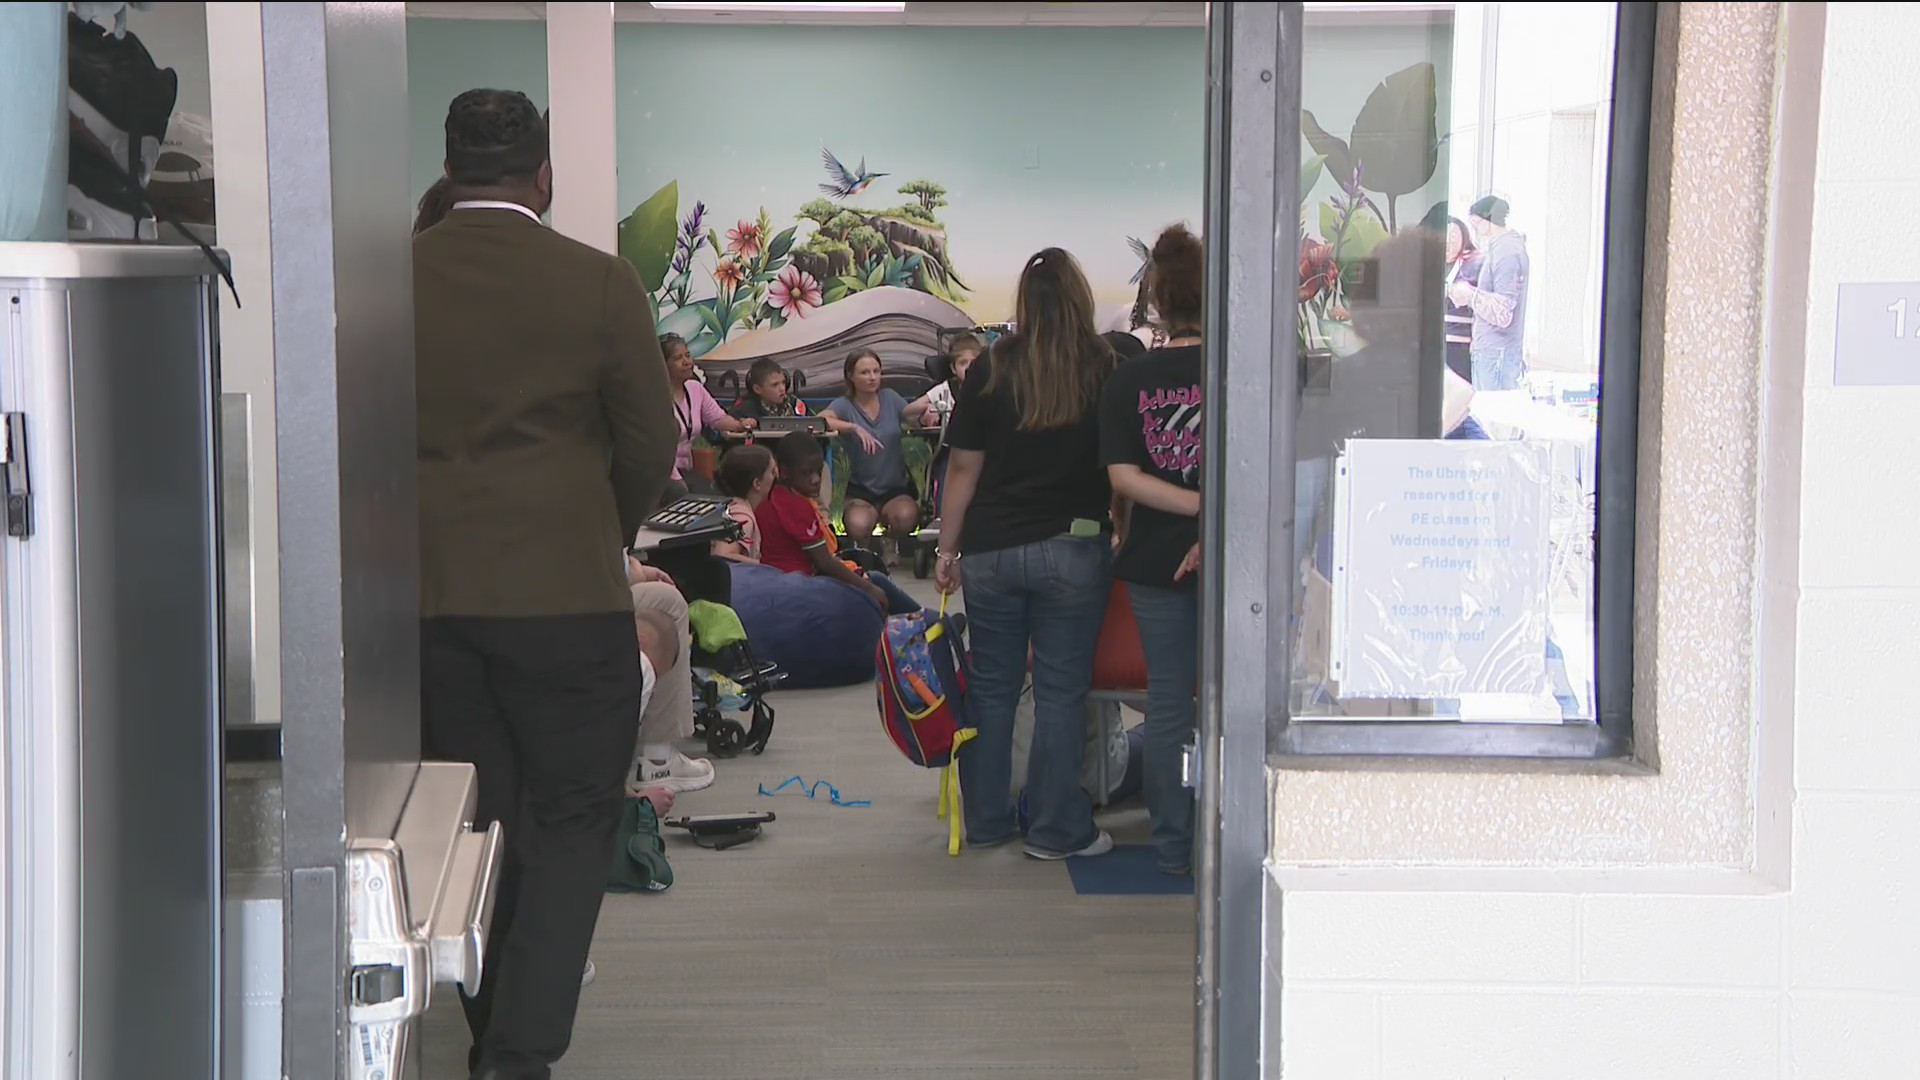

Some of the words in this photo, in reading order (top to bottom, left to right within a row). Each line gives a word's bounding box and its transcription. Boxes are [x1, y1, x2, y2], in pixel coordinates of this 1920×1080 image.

[1886, 297, 1920, 339] 1
[1408, 466, 1433, 479] The
[1485, 466, 1498, 479] is
[1403, 490, 1465, 502] reserved
[1411, 513, 1429, 525] PE
[1432, 513, 1470, 525] class
[1473, 515, 1491, 525] on
[1390, 534, 1480, 549] Wednesdays
[650, 769, 671, 780] HOKA
